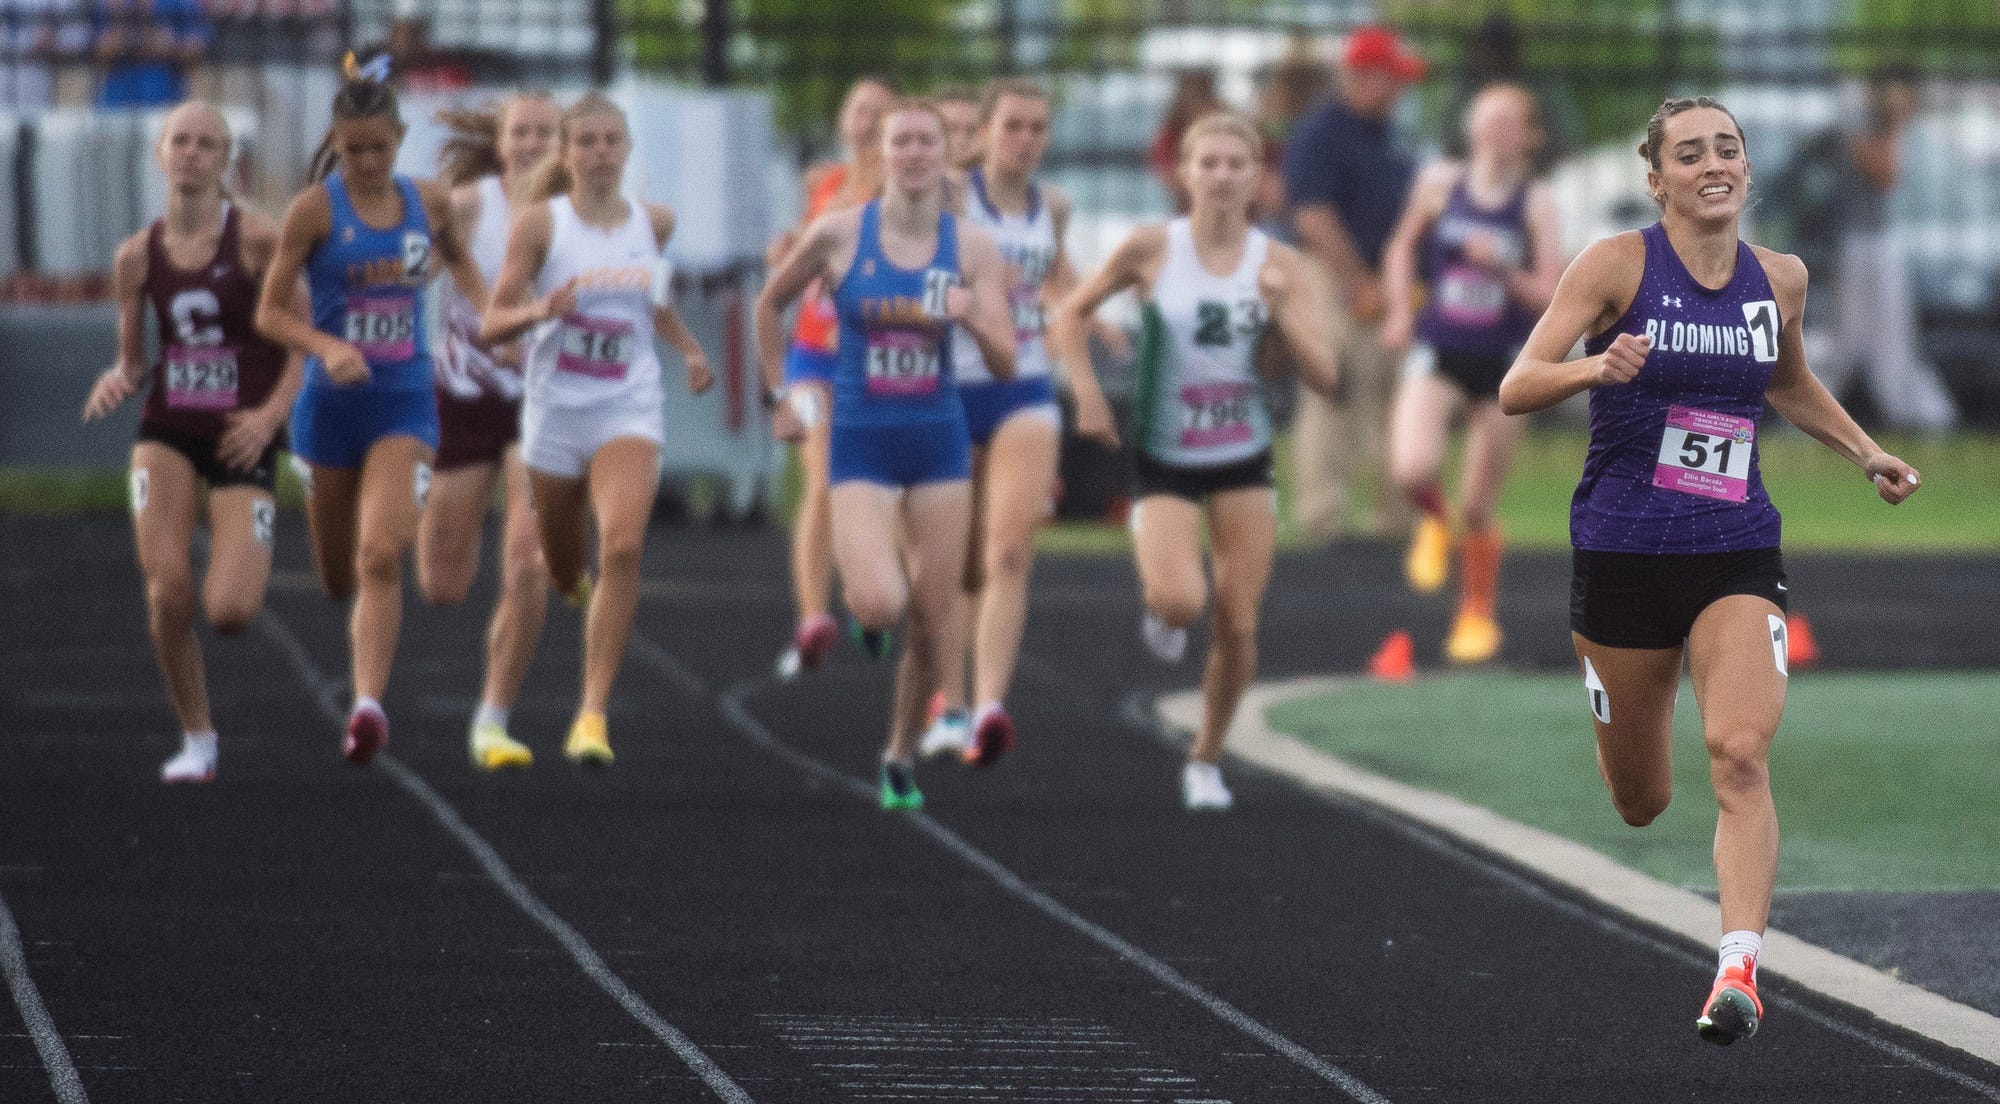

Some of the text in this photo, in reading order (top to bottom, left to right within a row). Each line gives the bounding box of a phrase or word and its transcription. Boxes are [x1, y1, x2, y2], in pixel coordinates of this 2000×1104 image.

[170, 288, 224, 346] C
[1749, 306, 1775, 357] 1
[579, 331, 620, 361] 16
[1645, 318, 1750, 356] BLOOMING
[876, 348, 938, 378] 107
[1679, 432, 1732, 473] 51
